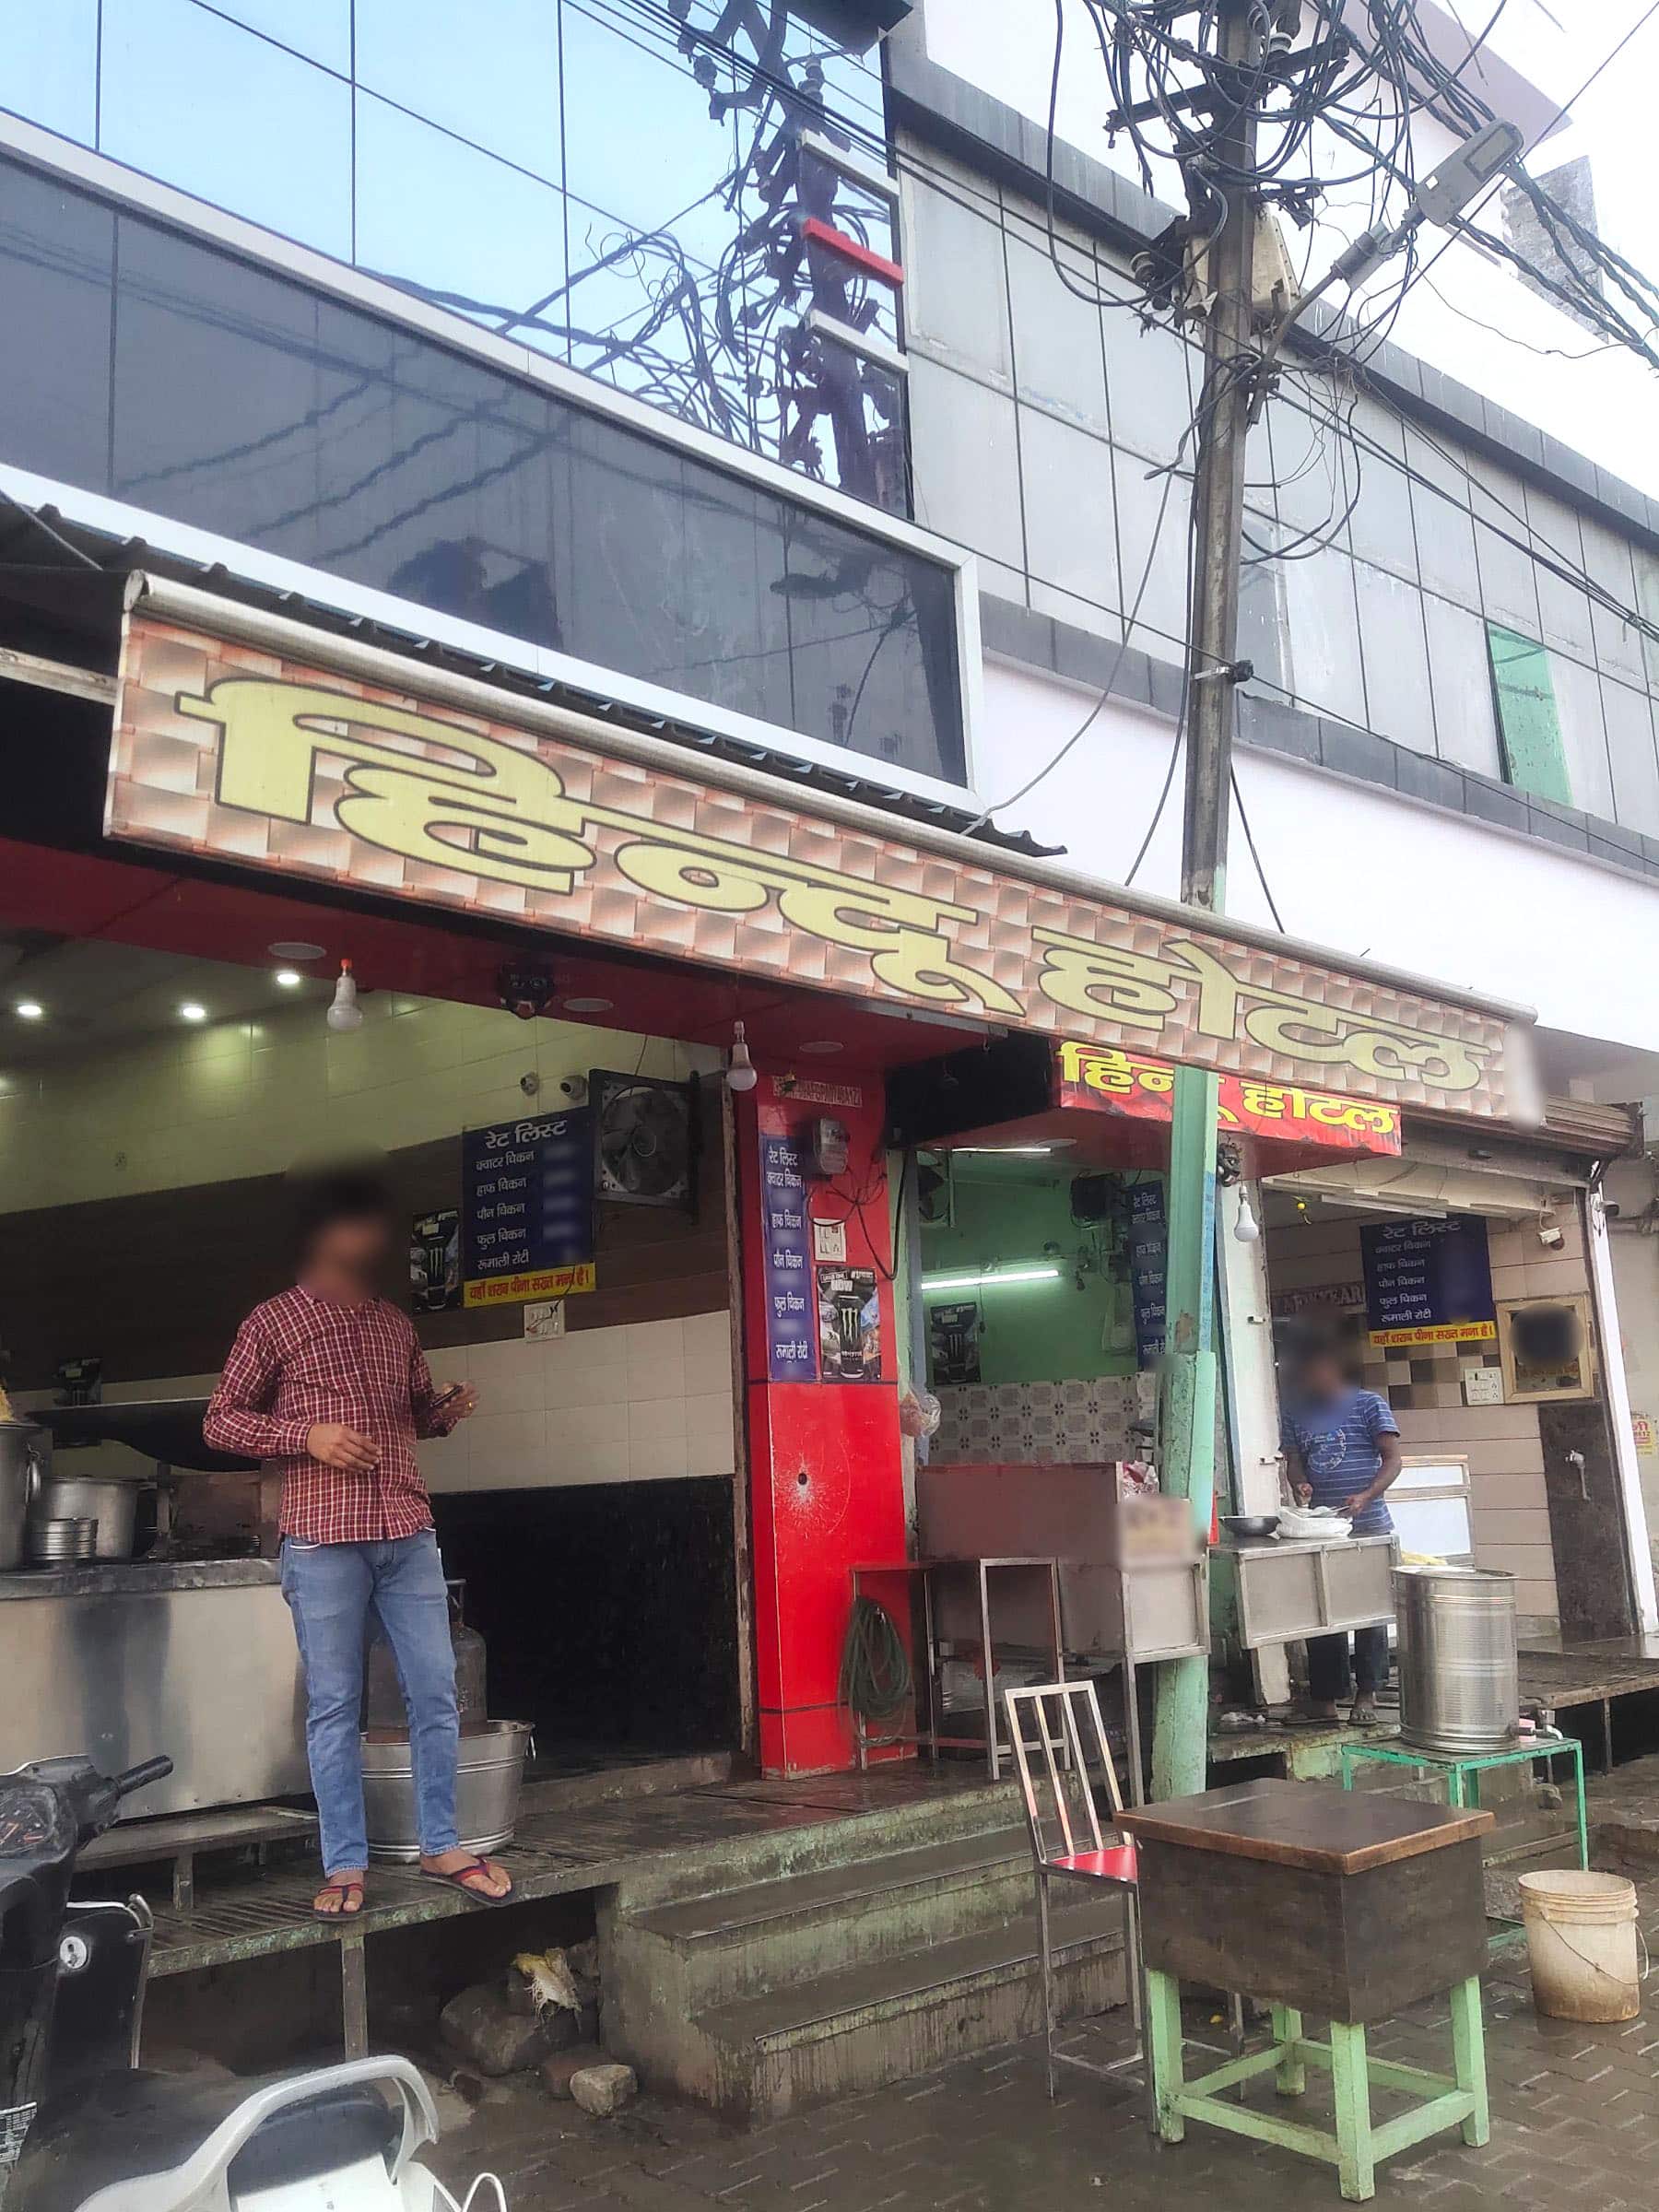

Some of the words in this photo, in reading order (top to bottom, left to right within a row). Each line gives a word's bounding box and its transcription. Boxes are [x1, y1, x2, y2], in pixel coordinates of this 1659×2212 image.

[175, 677, 1025, 1017] हिन्दू
[1031, 924, 1490, 1091] होटल
[485, 1131, 510, 1149] रेट
[514, 1120, 568, 1144] लिस्ट
[505, 1150, 535, 1166] चिकन
[476, 1182, 496, 1197] हाफ
[498, 1177, 527, 1193] चिकन
[497, 1202, 525, 1218] चिकन
[1382, 1226, 1407, 1240] रेट
[1411, 1219, 1461, 1236] लिस्ट
[477, 1232, 496, 1250] फुल
[498, 1228, 527, 1242] चिकन
[512, 1248, 529, 1265] रोटी
[1397, 1275, 1425, 1287] चिकन
[1399, 1292, 1428, 1304] चिकन
[1414, 1308, 1431, 1320] रोटी
